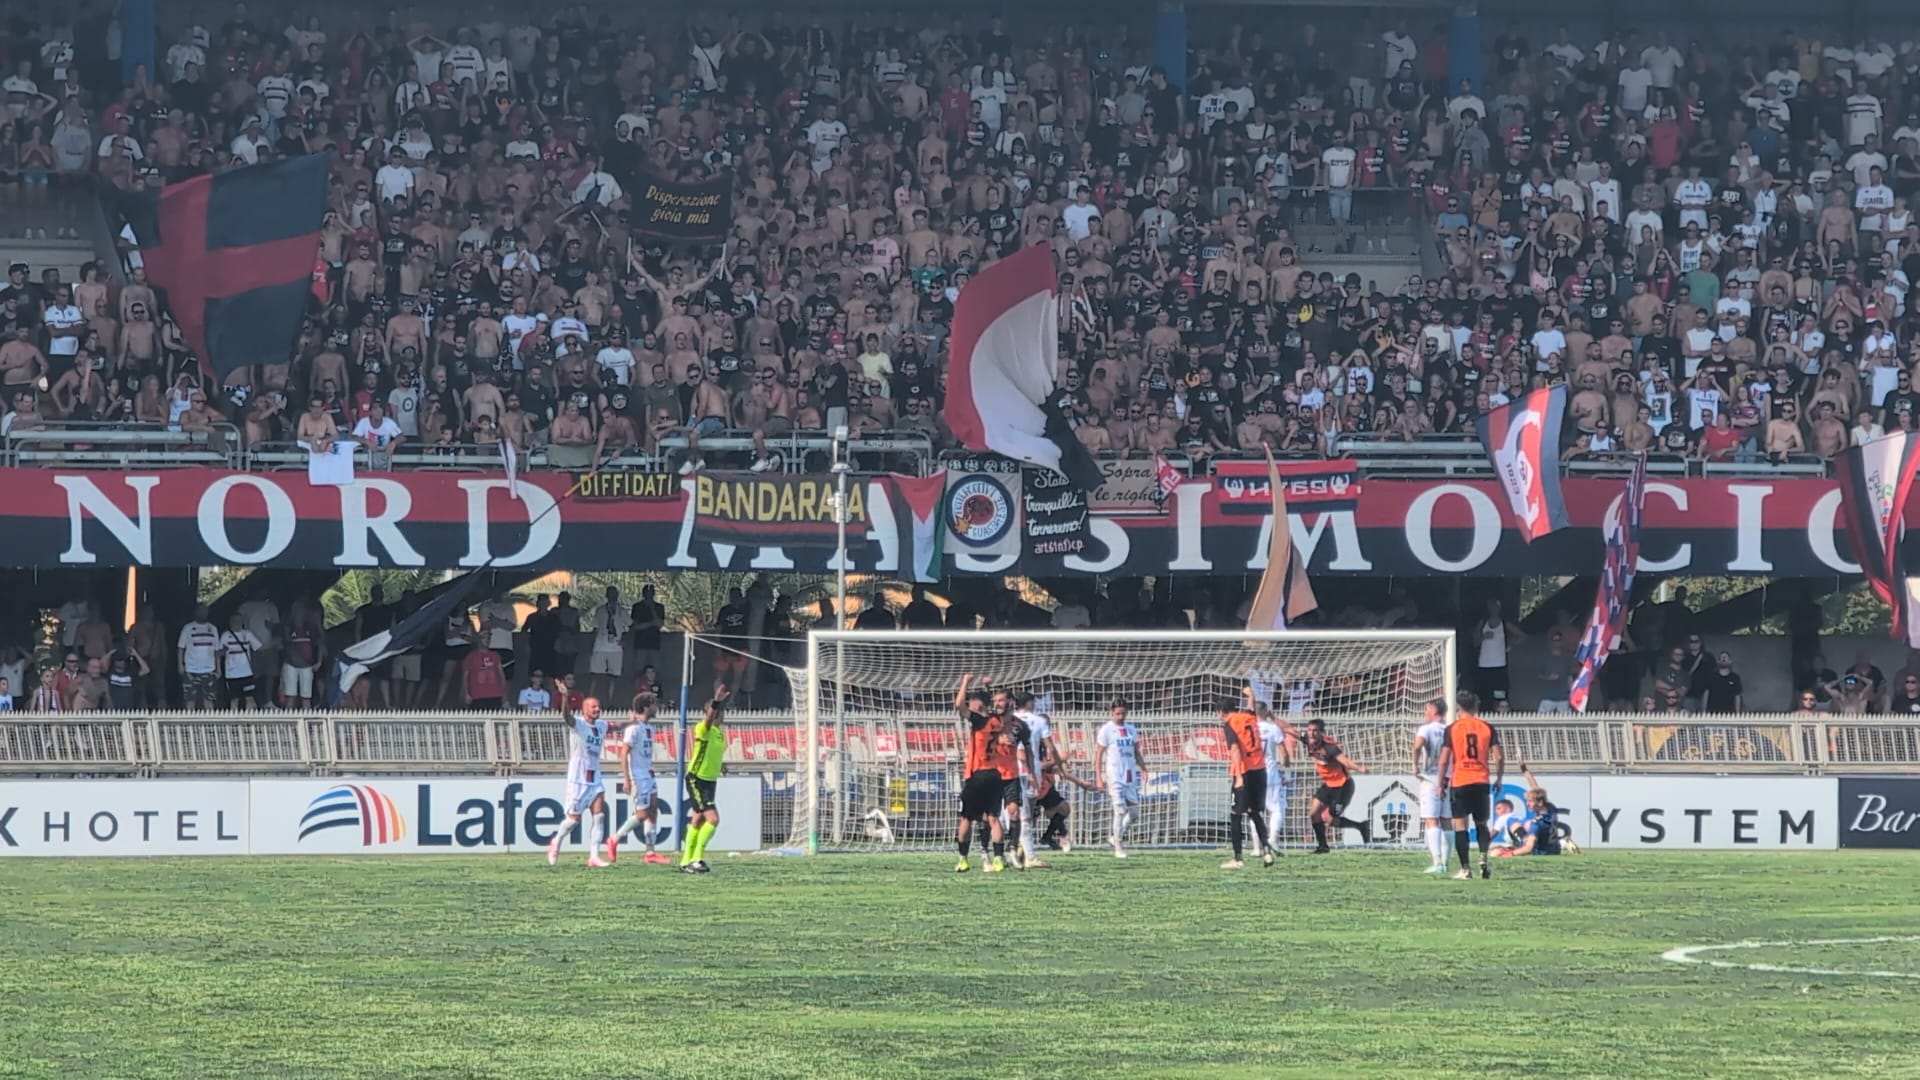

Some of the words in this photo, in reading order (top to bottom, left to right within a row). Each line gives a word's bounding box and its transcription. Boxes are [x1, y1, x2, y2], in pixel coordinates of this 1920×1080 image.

[645, 185, 721, 206] Disperazione
[650, 207, 682, 223] gioia
[686, 209, 710, 224] mia
[1103, 462, 1152, 482] Sopra
[580, 472, 672, 497] DIFFIDATI
[1095, 486, 1110, 501] le
[54, 475, 561, 567] NORD
[1466, 733, 1478, 758] 8
[44, 810, 239, 842] HOTEL
